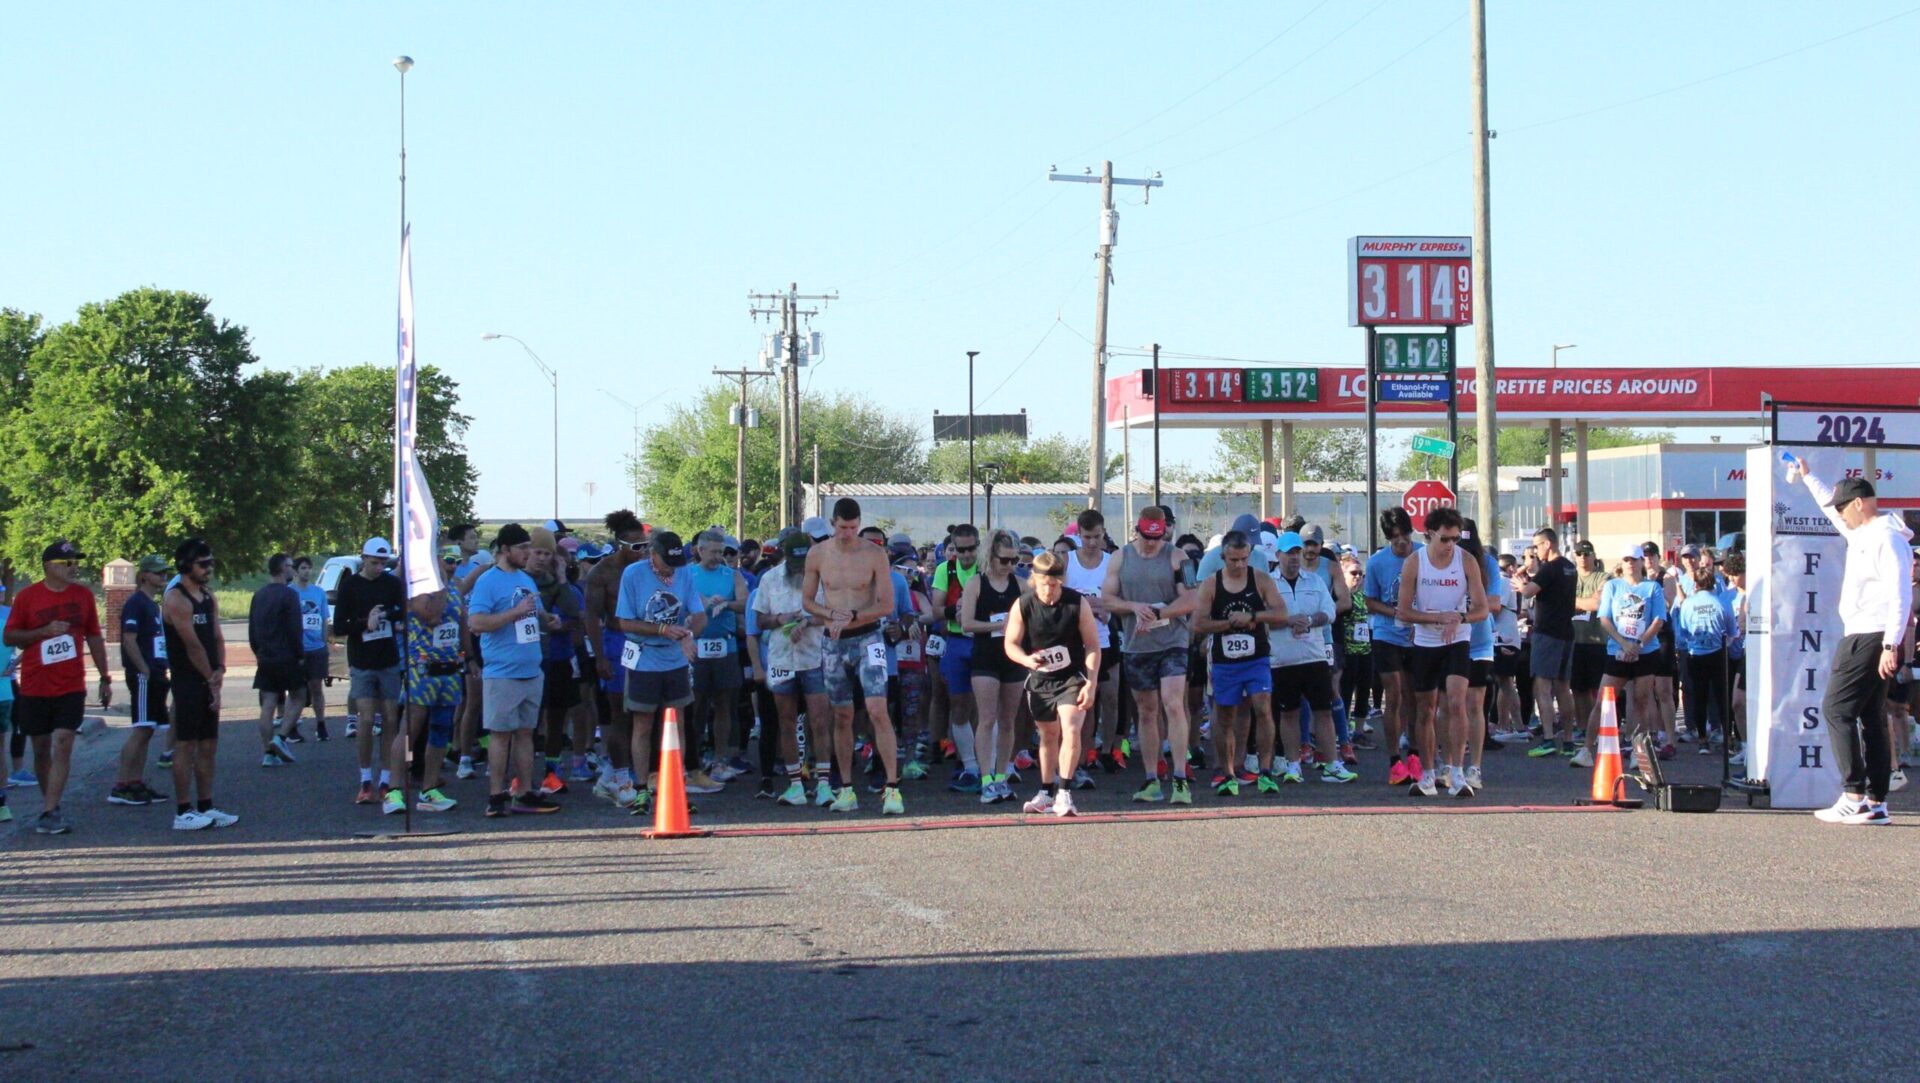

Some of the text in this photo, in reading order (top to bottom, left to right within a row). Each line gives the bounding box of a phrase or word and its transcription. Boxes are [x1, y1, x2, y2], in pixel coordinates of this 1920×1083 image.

[1362, 242, 1458, 252] MURPHY EXPRESS
[1391, 383, 1440, 391] Ethanol-Free
[1552, 379, 1613, 394] PRICES
[1617, 379, 1697, 394] AROUND
[1398, 391, 1434, 399] Available
[1817, 415, 1885, 443] 2024
[1784, 516, 1832, 526] WEST TEX
[1421, 579, 1458, 587] RUNLBK
[439, 628, 456, 640] 238
[525, 623, 536, 635] 81
[1624, 626, 1637, 637] 83
[47, 641, 72, 655] 420
[703, 642, 722, 652] 125
[1227, 639, 1249, 651] 293
[1799, 552, 1823, 768] FINISH
